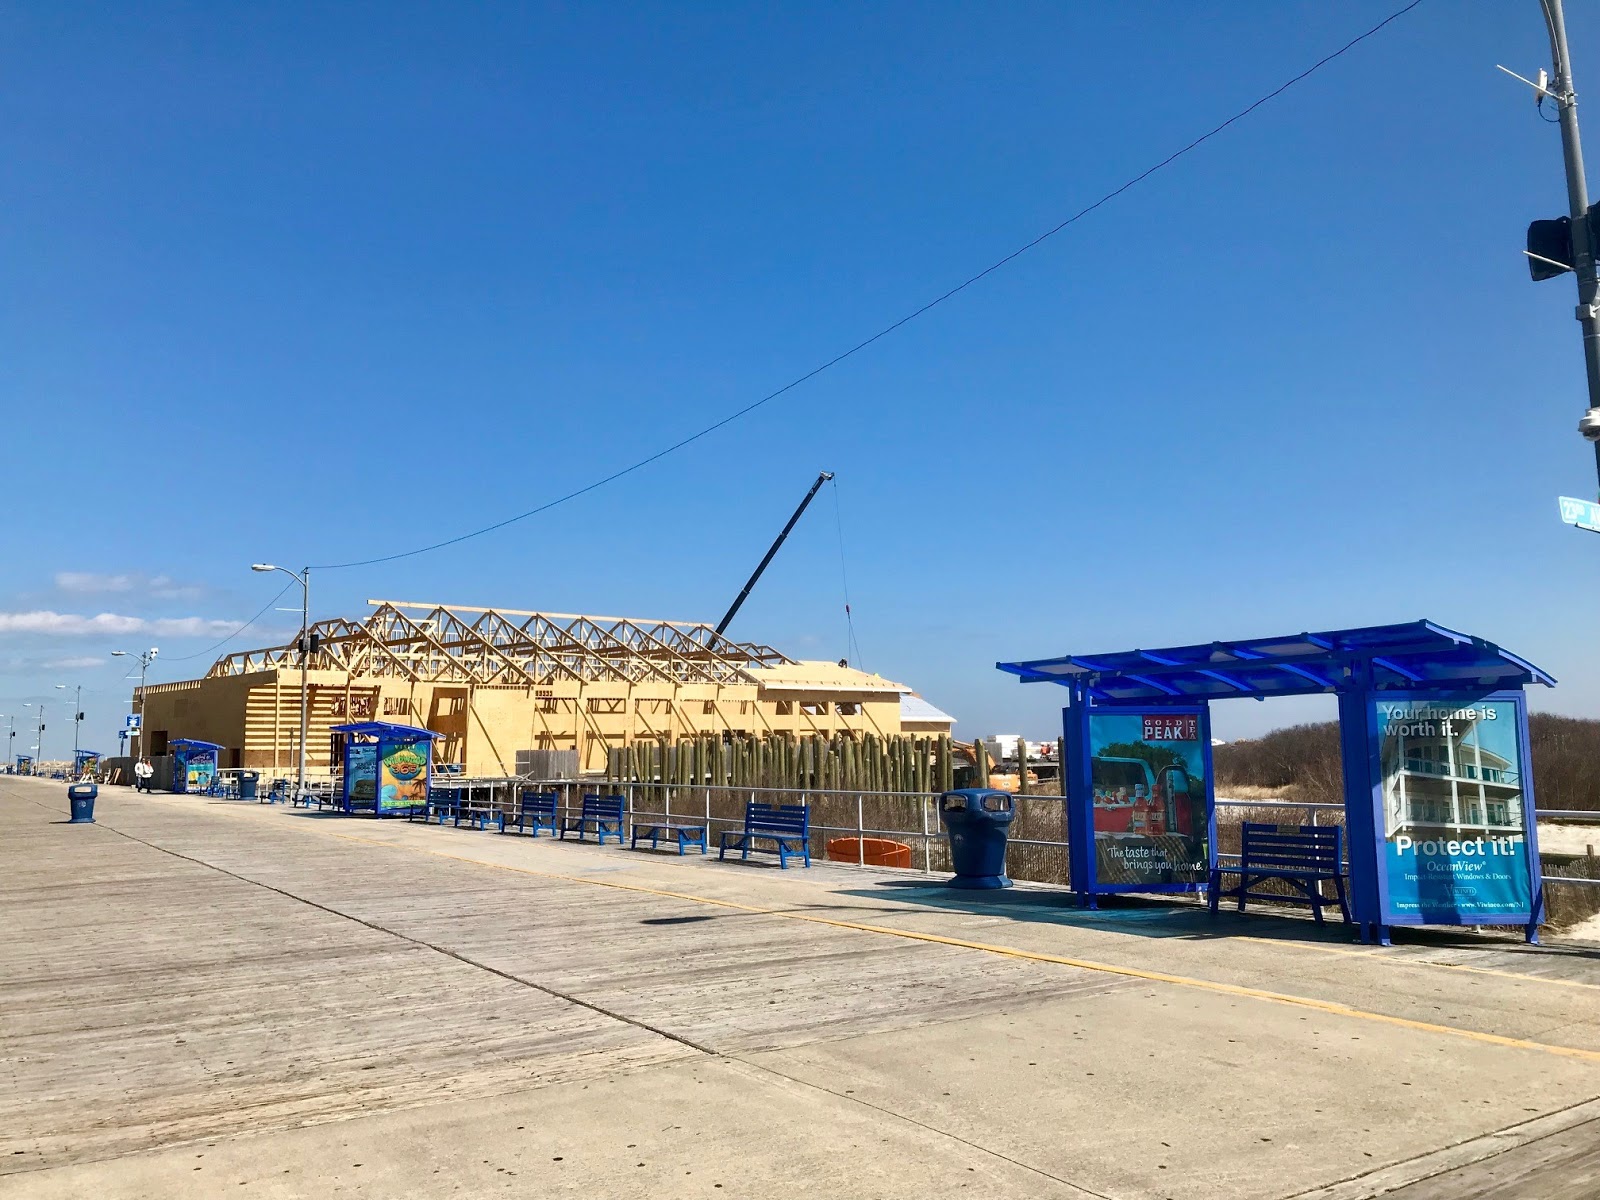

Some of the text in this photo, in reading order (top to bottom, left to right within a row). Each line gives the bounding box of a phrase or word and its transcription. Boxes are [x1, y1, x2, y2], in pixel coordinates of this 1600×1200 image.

[1382, 705, 1497, 720] Your home is
[1144, 727, 1183, 739] PEAK
[1383, 722, 1459, 737] worth it.
[391, 764, 417, 775] 365
[1107, 844, 1168, 858] The taste that
[1396, 835, 1515, 856] Protect it!
[1123, 857, 1153, 874] brings
[1154, 861, 1173, 875] you
